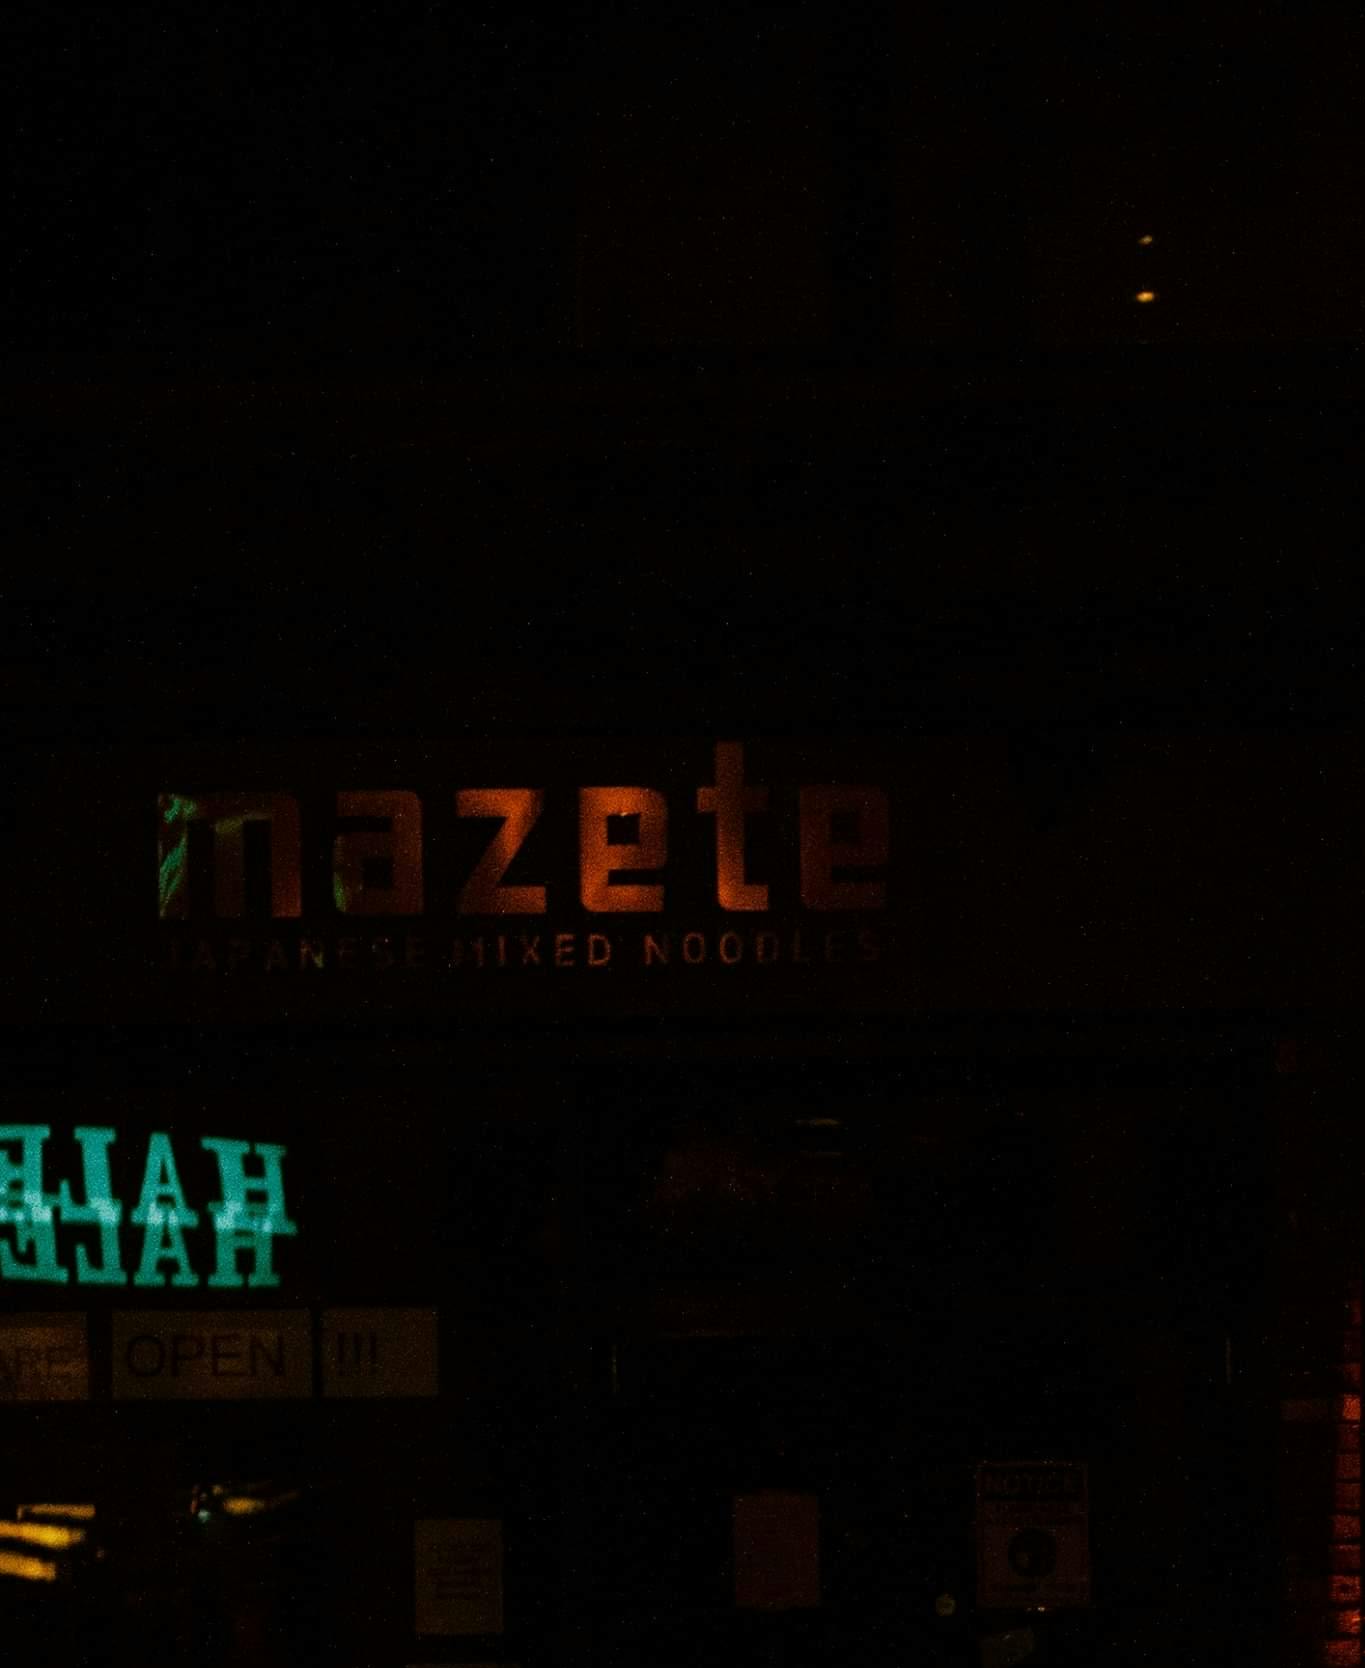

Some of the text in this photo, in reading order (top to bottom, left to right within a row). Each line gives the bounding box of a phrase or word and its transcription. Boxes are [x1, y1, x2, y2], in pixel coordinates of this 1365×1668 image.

[157, 738, 891, 919] mazete
[166, 926, 882, 972] JAPANESE MIXED NOODLES
[126, 1332, 285, 1378] OPEN
